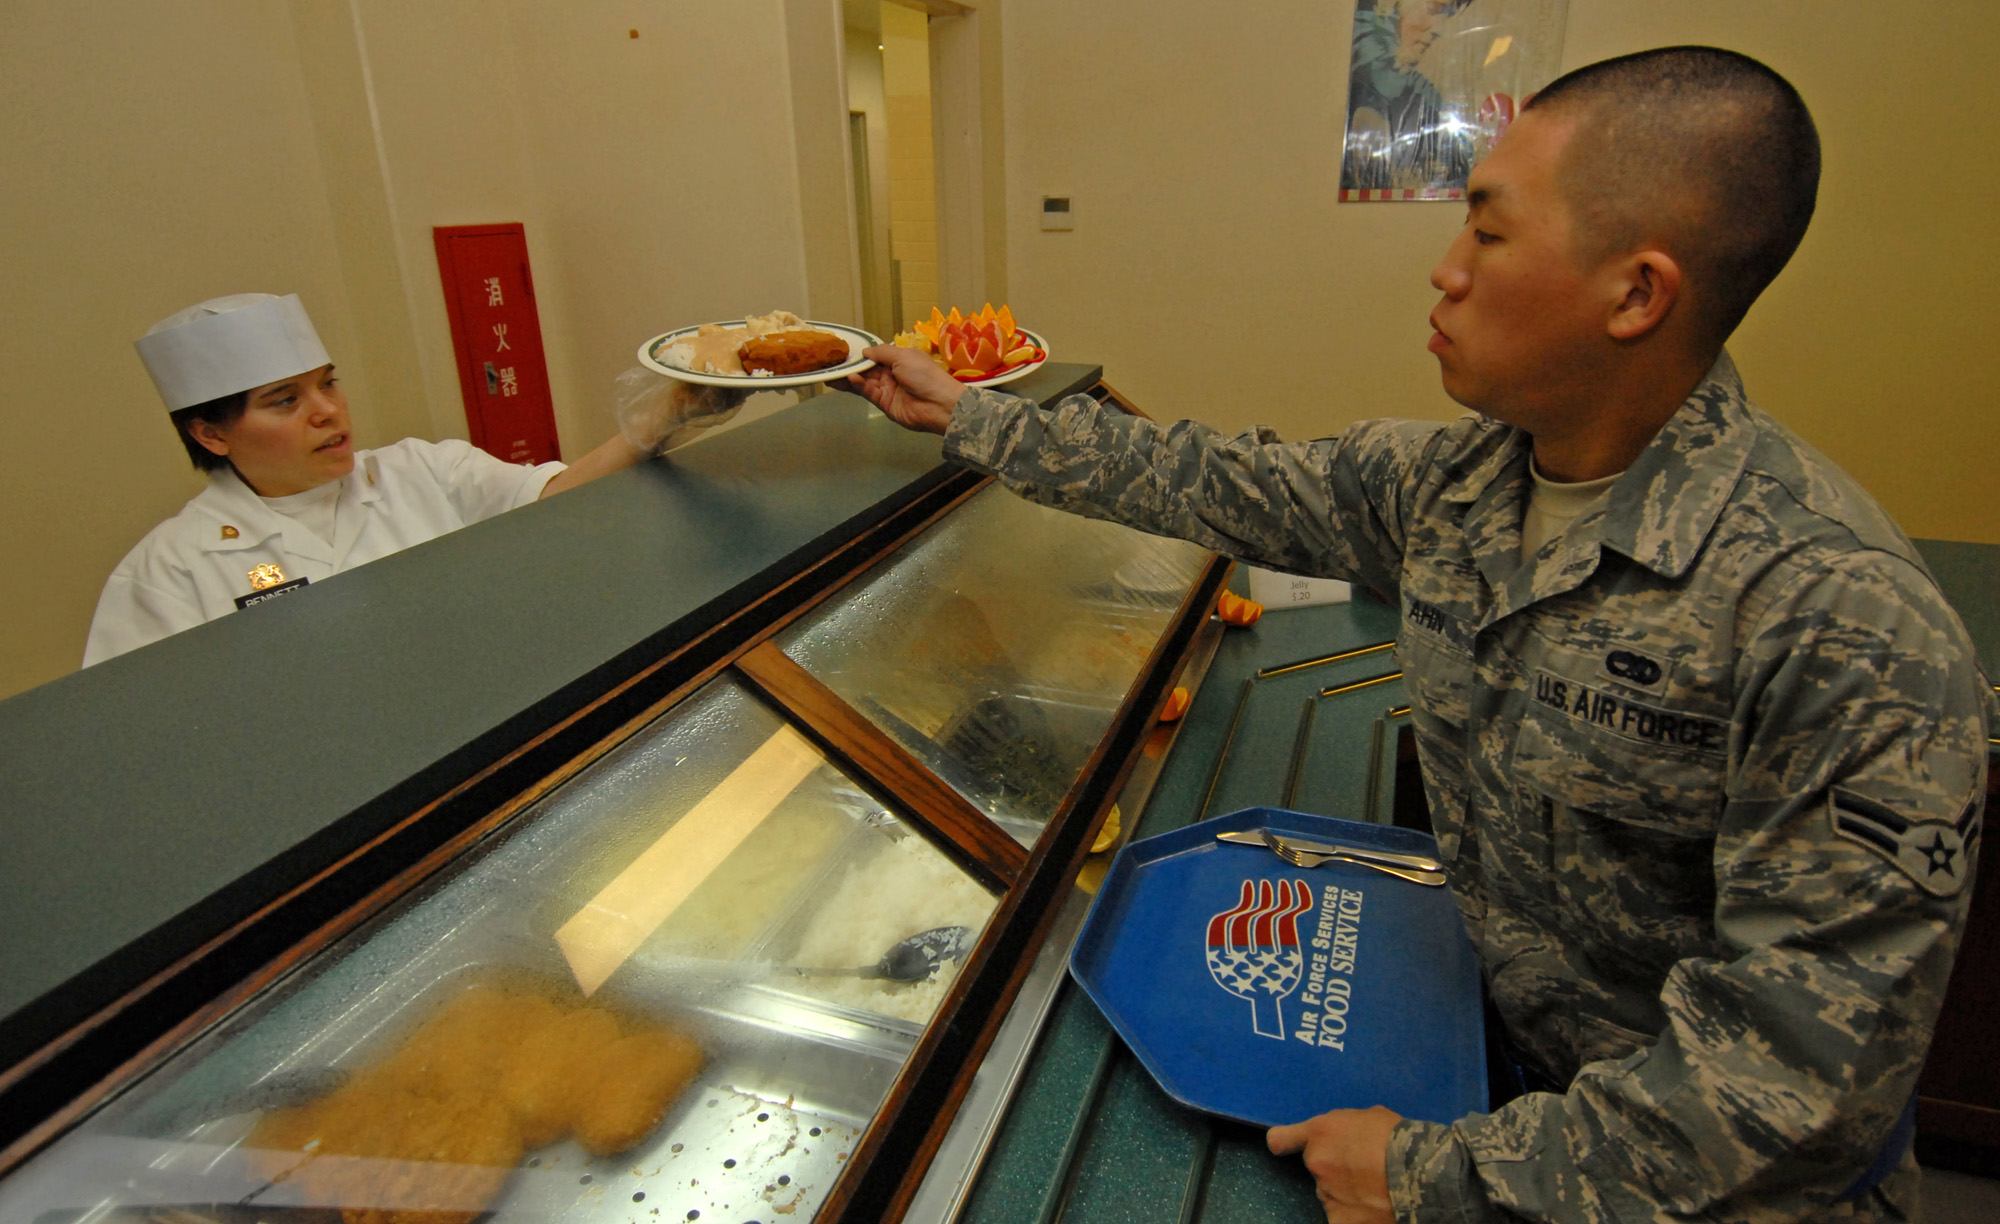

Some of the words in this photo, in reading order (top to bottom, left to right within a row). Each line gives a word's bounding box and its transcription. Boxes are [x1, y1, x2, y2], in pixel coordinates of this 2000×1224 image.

[484, 276, 518, 397] 消火器
[1291, 581, 1309, 590] Jelly
[1292, 591, 1311, 601] $.20
[1408, 601, 1446, 634] AHN
[1536, 673, 1568, 713] U.S.
[1573, 688, 1617, 728] AIR
[1621, 703, 1720, 749] FORCE
[1312, 885, 1339, 950] SERVICES
[1329, 889, 1363, 975] SERVICE
[1301, 953, 1328, 1005] FORCE
[1295, 1010, 1319, 1046] AIR
[1318, 978, 1351, 1052] FOOD
